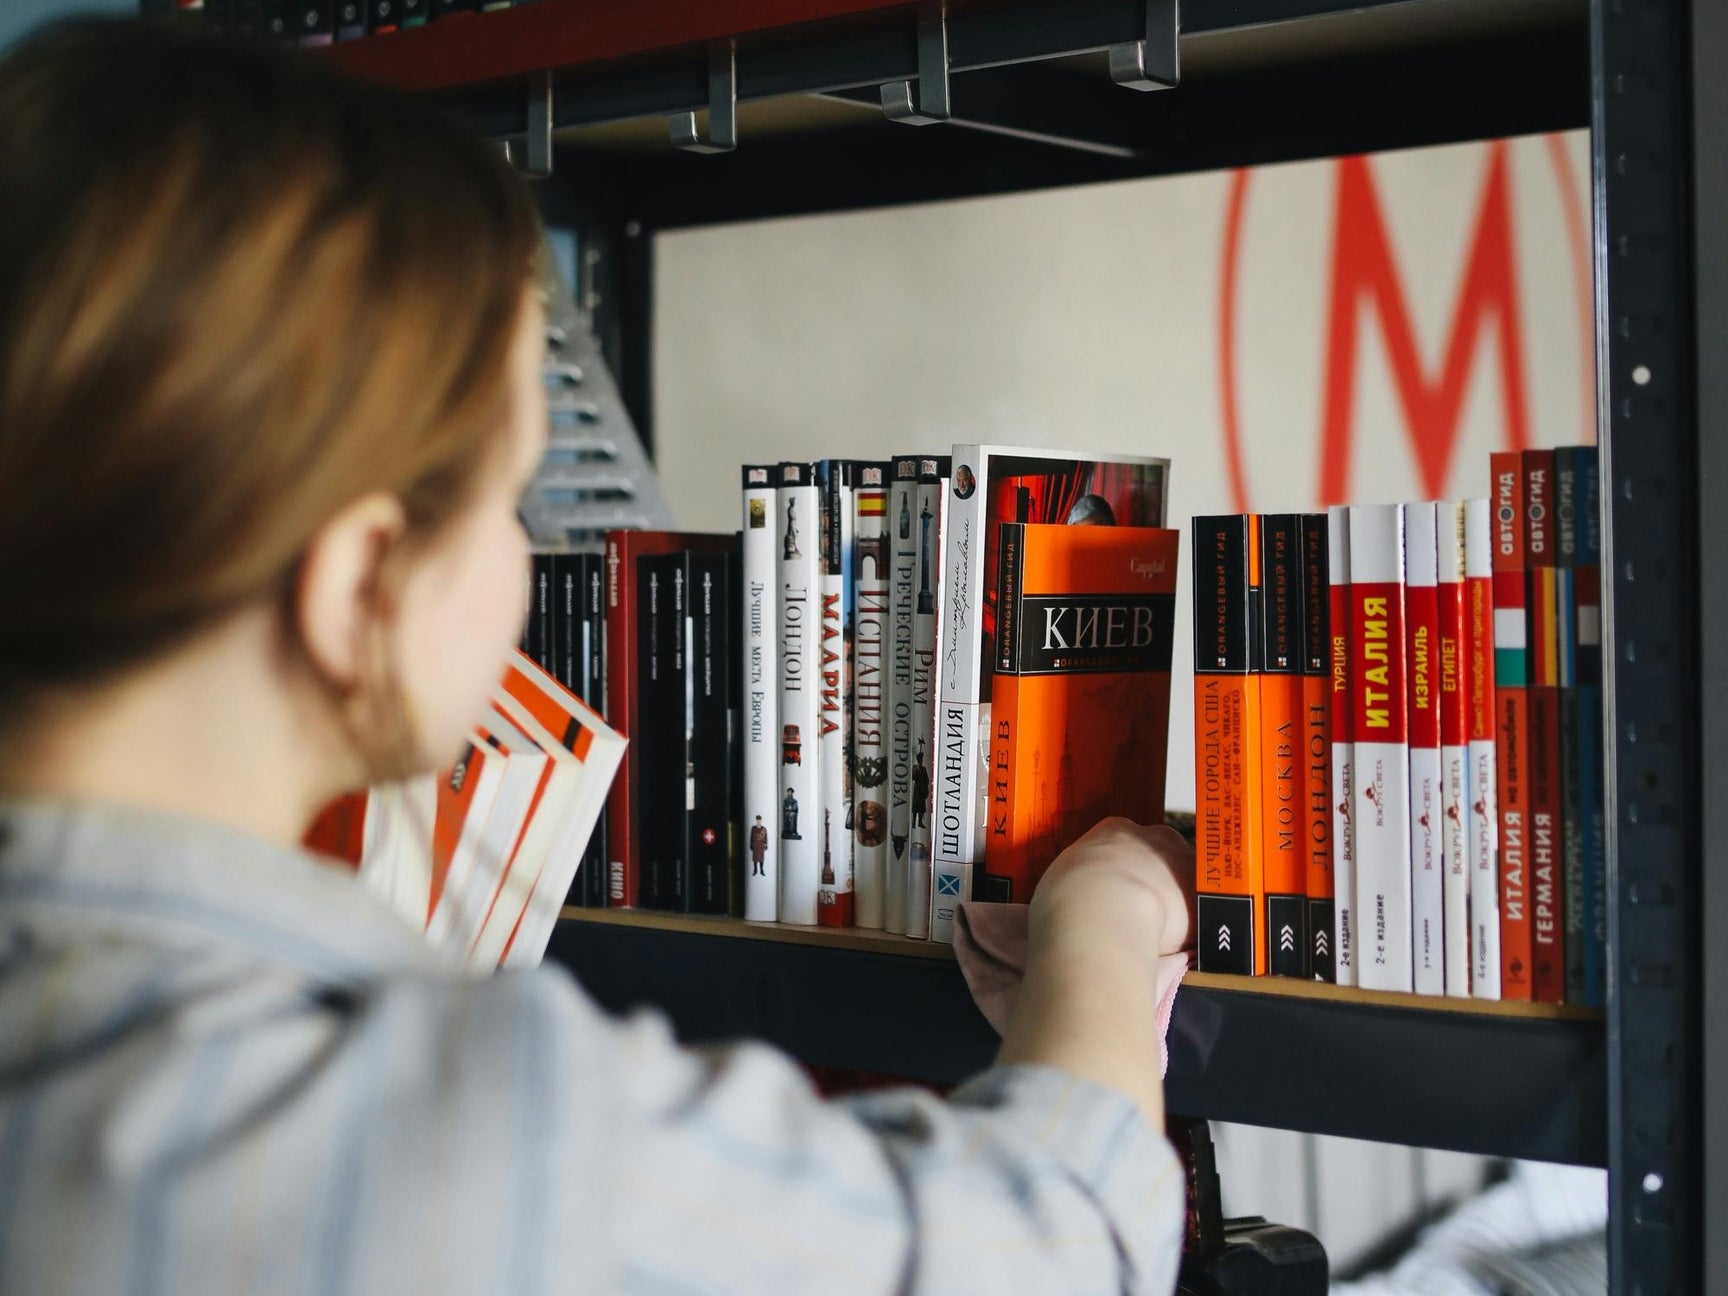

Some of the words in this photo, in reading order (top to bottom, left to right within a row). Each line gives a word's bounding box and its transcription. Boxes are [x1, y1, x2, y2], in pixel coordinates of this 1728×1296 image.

[1006, 543, 1015, 569] ГИД
[750, 581, 765, 637] ЛУЧШИЕ
[895, 550, 917, 686] ГРЕЧЕСКИЕ
[1041, 606, 1155, 650] КИЕВ
[751, 646, 762, 684] МЕСТА
[782, 583, 808, 692] ЛОНДОН
[818, 593, 840, 737] МАДРИД
[1334, 637, 1347, 692] ТУРЦИЯ
[1364, 597, 1389, 728] ИТАЛИЯ
[1441, 636, 1457, 692] ЕГИПЕТ
[858, 587, 890, 747] ИСПАНИЯ
[913, 648, 934, 706] РИМ
[1415, 626, 1429, 709] ИЗРАИЛЬ
[751, 691, 765, 743] ЕВРОПЫ
[1204, 680, 1219, 724] США
[892, 703, 910, 809] ОСТРОВА
[942, 708, 965, 857] ШОТЛАНДИЯ
[995, 720, 1010, 836] КИЕВ
[1205, 729, 1220, 802] ГОРОДА
[1343, 763, 1351, 797] СВЕТА
[1375, 759, 1383, 789] СВЕТА
[1451, 759, 1461, 799] СВЕТА
[1478, 754, 1488, 793] СВЕТА
[1276, 720, 1295, 851] МОСКВА
[1309, 703, 1329, 871] ЛОНДОН
[1423, 778, 1432, 810] СВЕТА
[1205, 807, 1221, 888] ЛУЧШИЕ
[1505, 811, 1523, 920] ИТАЛИЯ
[1534, 812, 1554, 944] ГЕРМАНИЯ
[1340, 909, 1350, 950] издание
[1375, 894, 1385, 941] издание
[1341, 952, 1350, 967] 2-е
[1375, 945, 1385, 964] 2-е
